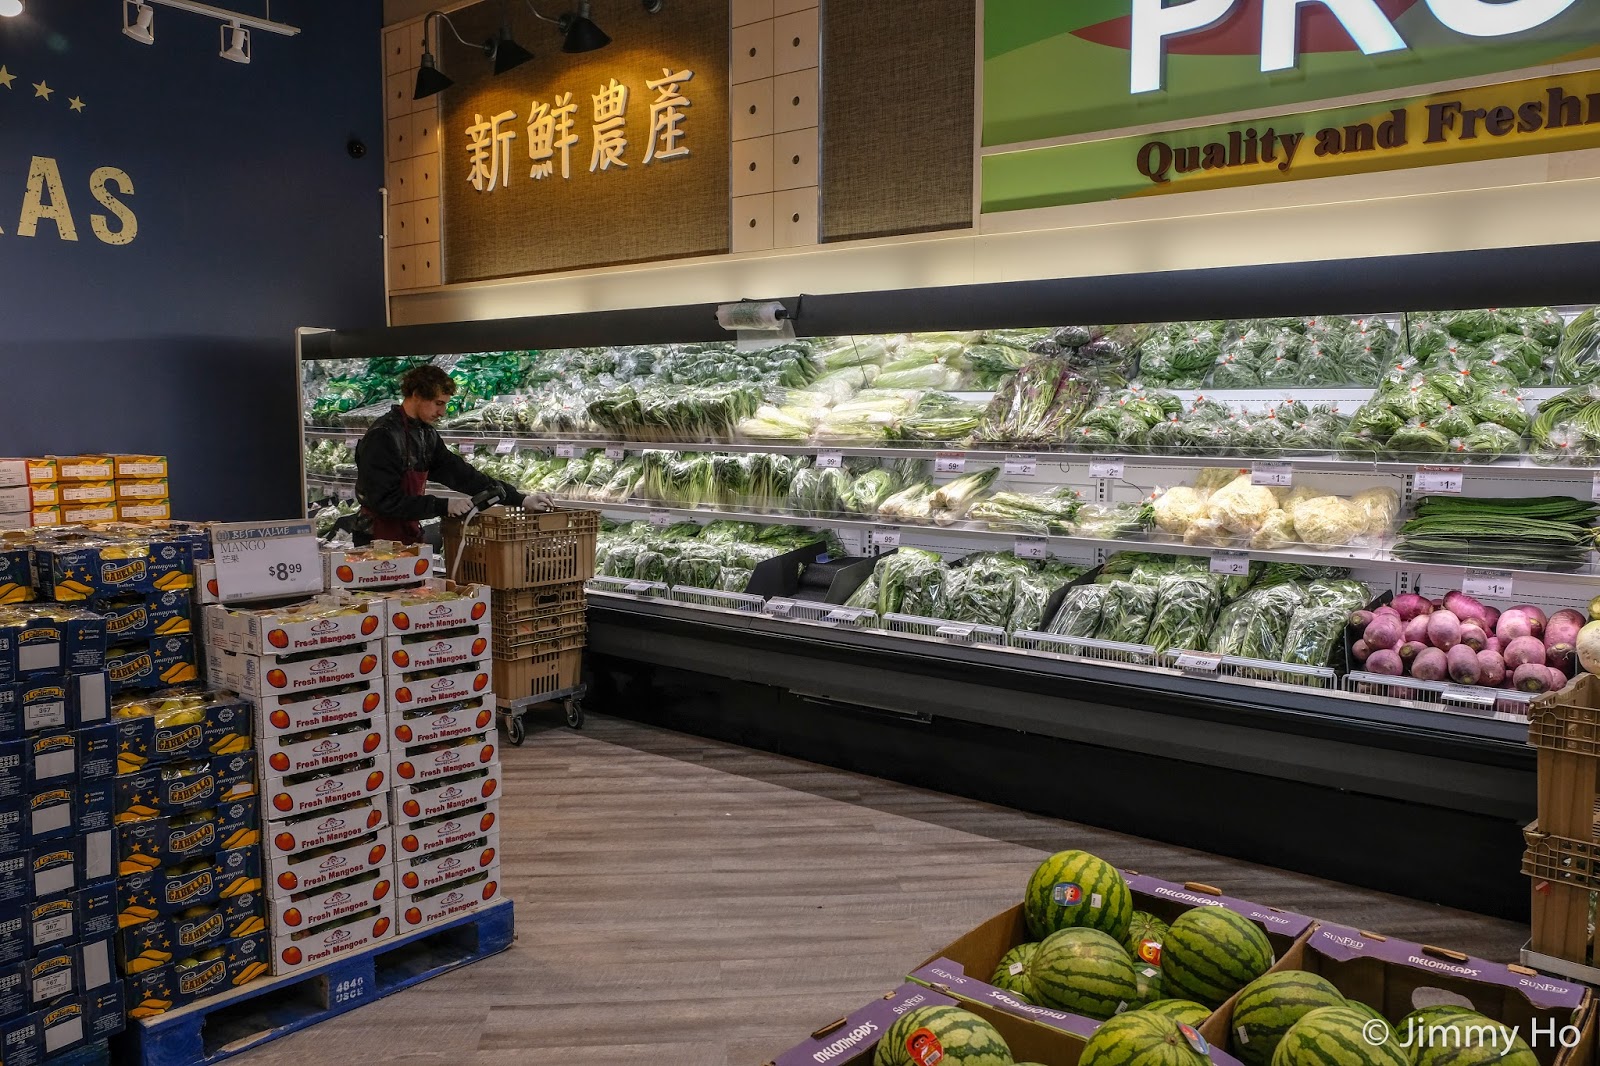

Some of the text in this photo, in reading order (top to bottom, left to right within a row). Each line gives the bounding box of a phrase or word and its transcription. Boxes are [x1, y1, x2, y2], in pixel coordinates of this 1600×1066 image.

[1130, 0, 1580, 94] PR
[464, 67, 694, 192] 新鮮農產
[1136, 127, 1304, 185] Quality
[1314, 108, 1408, 157] and
[0, 155, 138, 246] AS
[232, 529, 256, 540] BEST
[258, 526, 290, 537] VALUE
[220, 540, 266, 554] MANGO
[104, 562, 144, 582] CABELLO
[107, 609, 144, 630] CABELLO
[415, 618, 466, 630] Fresh Mangoes
[295, 633, 356, 648] Fresh Mangoes
[110, 658, 149, 678] CABELLO
[415, 655, 467, 667] Fresh Mangoes
[294, 672, 354, 687] Fresh Mangoes
[417, 690, 468, 704] Fresh Mangoes
[297, 711, 357, 727] Fresh Mangoes
[158, 727, 199, 750] CABELLO
[418, 727, 471, 741] Fresh Mangoes
[296, 751, 358, 769] Fresh Mangoes
[421, 761, 475, 778] Fresh Mangoes
[171, 778, 210, 800] CABELLO
[300, 790, 361, 809] Fresh Mangoes
[425, 797, 477, 815] Fresh Mangoes
[171, 826, 211, 849] CABELLO
[302, 828, 361, 848] Fresh Mangoes
[424, 831, 475, 849] Fresh Mangoes
[304, 864, 363, 887] Fresh Mangoes
[424, 866, 475, 886] Fresh Mangoes
[168, 875, 209, 900] CABELLO
[309, 900, 368, 924] Fresh Mangoes
[427, 900, 478, 921] Fresh Mangoes
[182, 916, 220, 942] CABELLO
[308, 938, 367, 961] Fresh Mangoes
[183, 964, 222, 990] CABELLO
